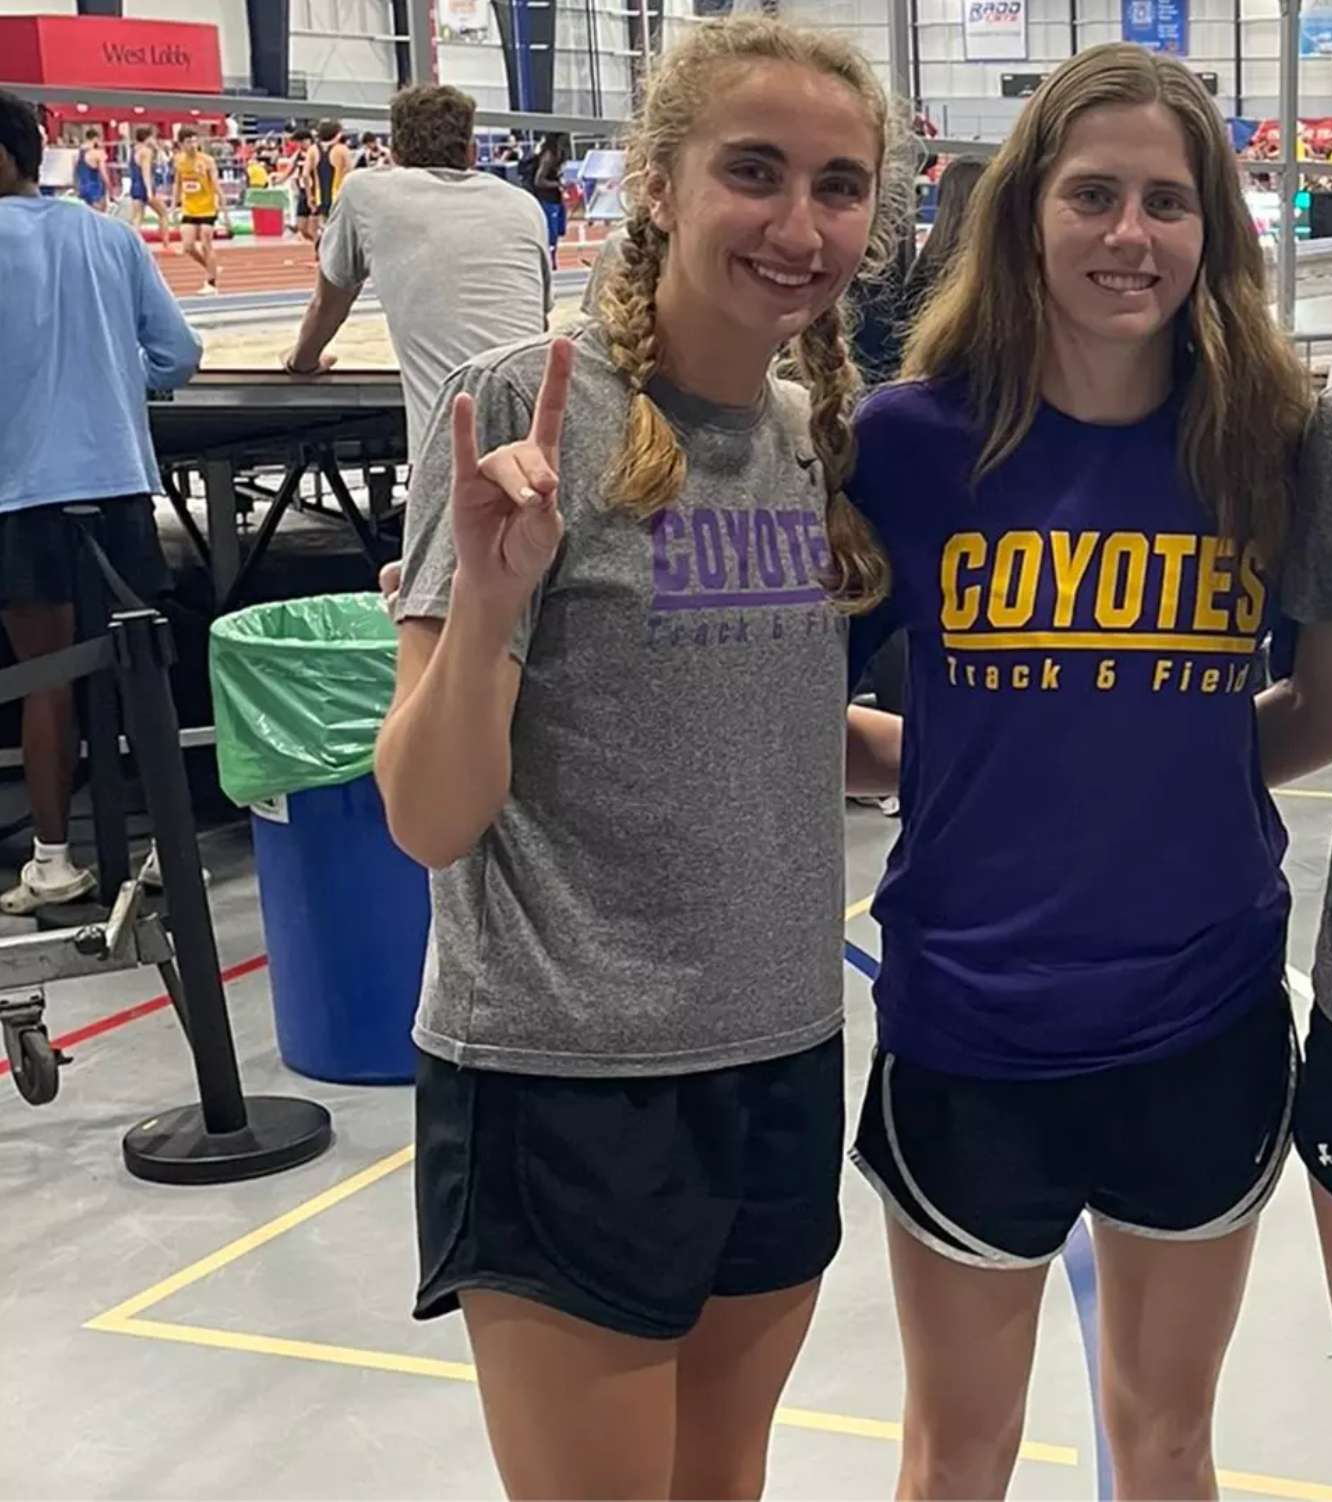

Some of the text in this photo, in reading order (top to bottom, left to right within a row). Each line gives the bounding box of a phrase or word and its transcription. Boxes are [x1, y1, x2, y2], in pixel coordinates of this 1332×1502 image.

[102, 41, 191, 72] West Lobby
[653, 507, 838, 591] COYOTE
[940, 530, 1267, 633] COYOTES
[650, 614, 751, 647] Track
[947, 656, 1063, 691] Track
[1152, 659, 1250, 694] Field
